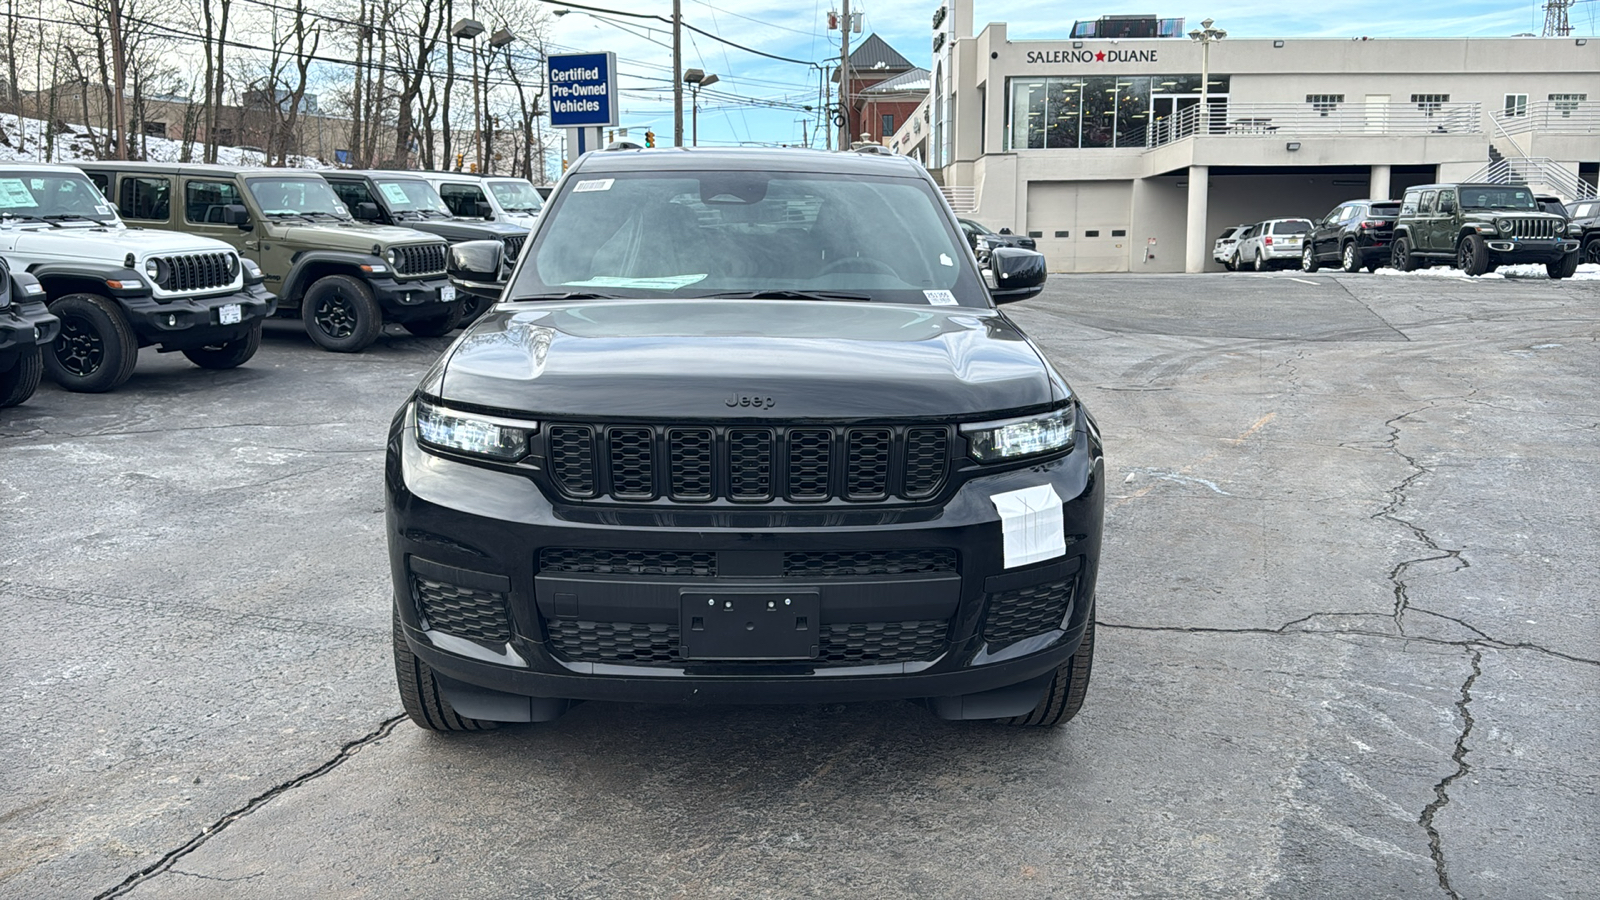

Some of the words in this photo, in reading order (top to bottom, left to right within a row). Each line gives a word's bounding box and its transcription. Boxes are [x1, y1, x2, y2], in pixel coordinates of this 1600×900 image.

[1026, 50, 1094, 63] SALERNO
[1107, 50, 1158, 62] DUANE
[551, 66, 599, 81] Certified
[552, 82, 607, 97] Pre-Owned
[553, 98, 600, 113] Vehicles
[724, 391, 776, 411] Jeep
